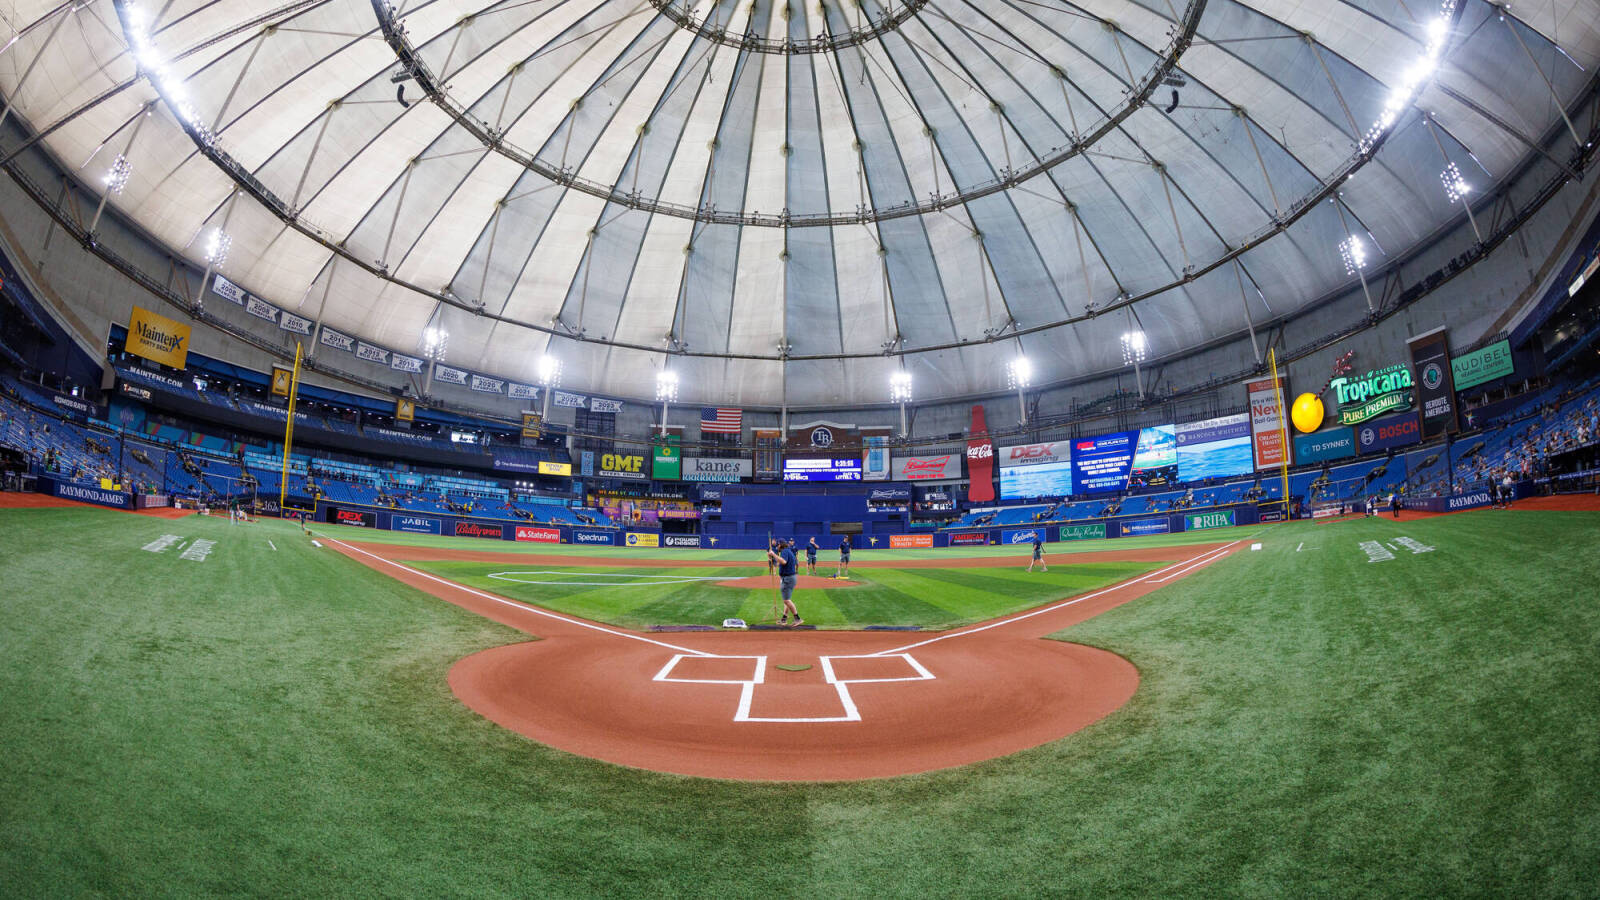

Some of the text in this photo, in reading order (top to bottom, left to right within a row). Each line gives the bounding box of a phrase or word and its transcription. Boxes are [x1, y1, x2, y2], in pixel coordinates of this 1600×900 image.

[221, 284, 236, 296] 2008
[288, 320, 303, 328] 2010
[136, 320, 184, 352] MaintenX
[329, 334, 344, 344] 2011
[1455, 347, 1510, 372] AUDIBEL
[1331, 369, 1412, 403] Tropicana
[254, 403, 307, 419] MAINTENXCOM
[1253, 404, 1283, 417] New
[1343, 394, 1404, 422] PURE PREMIUM
[1425, 404, 1451, 418] AMERICAS
[1380, 420, 1418, 439] BOSCH
[815, 431, 829, 445] TB
[1322, 440, 1349, 450] SYNNEX
[1010, 443, 1054, 460] DEX
[602, 454, 644, 472] GMF
[696, 459, 741, 472] kane's
[60, 484, 123, 504] RAYMOND JAMES
[1450, 494, 1488, 508] RAYMOND
[337, 511, 363, 521] DEX
[1203, 514, 1228, 526] RIPA
[456, 522, 502, 537] Bally SPORTS
[1062, 526, 1103, 537] Quality Roofing
[577, 533, 608, 542] Spectrum
